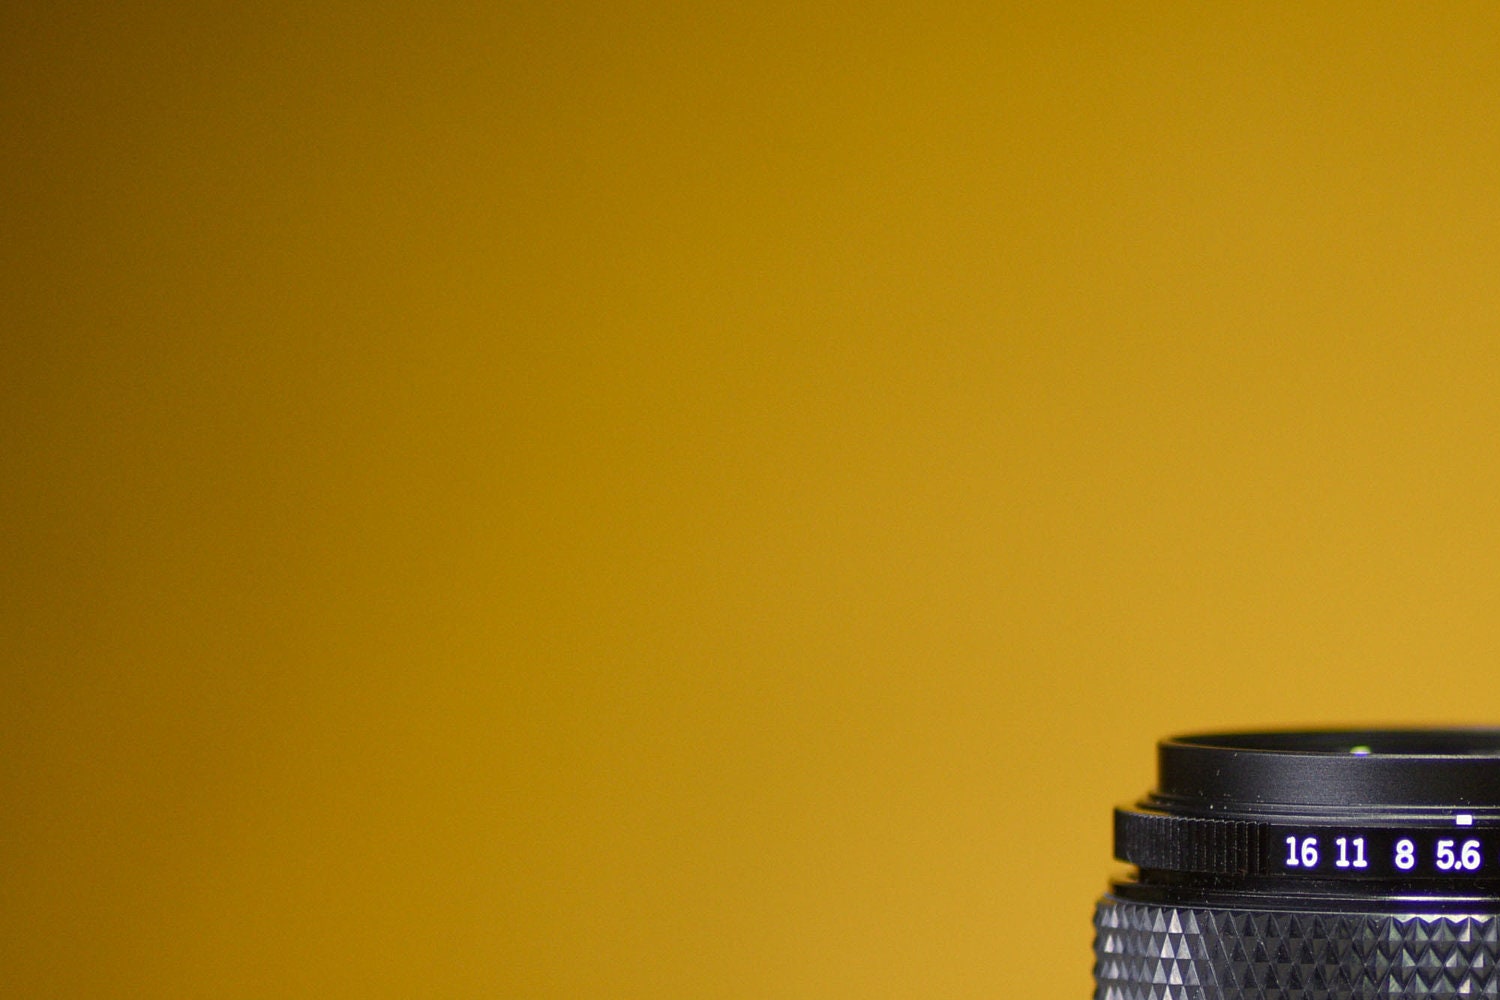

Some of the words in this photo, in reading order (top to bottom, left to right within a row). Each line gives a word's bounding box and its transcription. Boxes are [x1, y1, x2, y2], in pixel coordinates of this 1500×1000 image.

[1286, 836, 1318, 868] 16
[1335, 837, 1368, 868] 11
[1394, 839, 1415, 870] 8
[1436, 839, 1481, 870] 5.6
